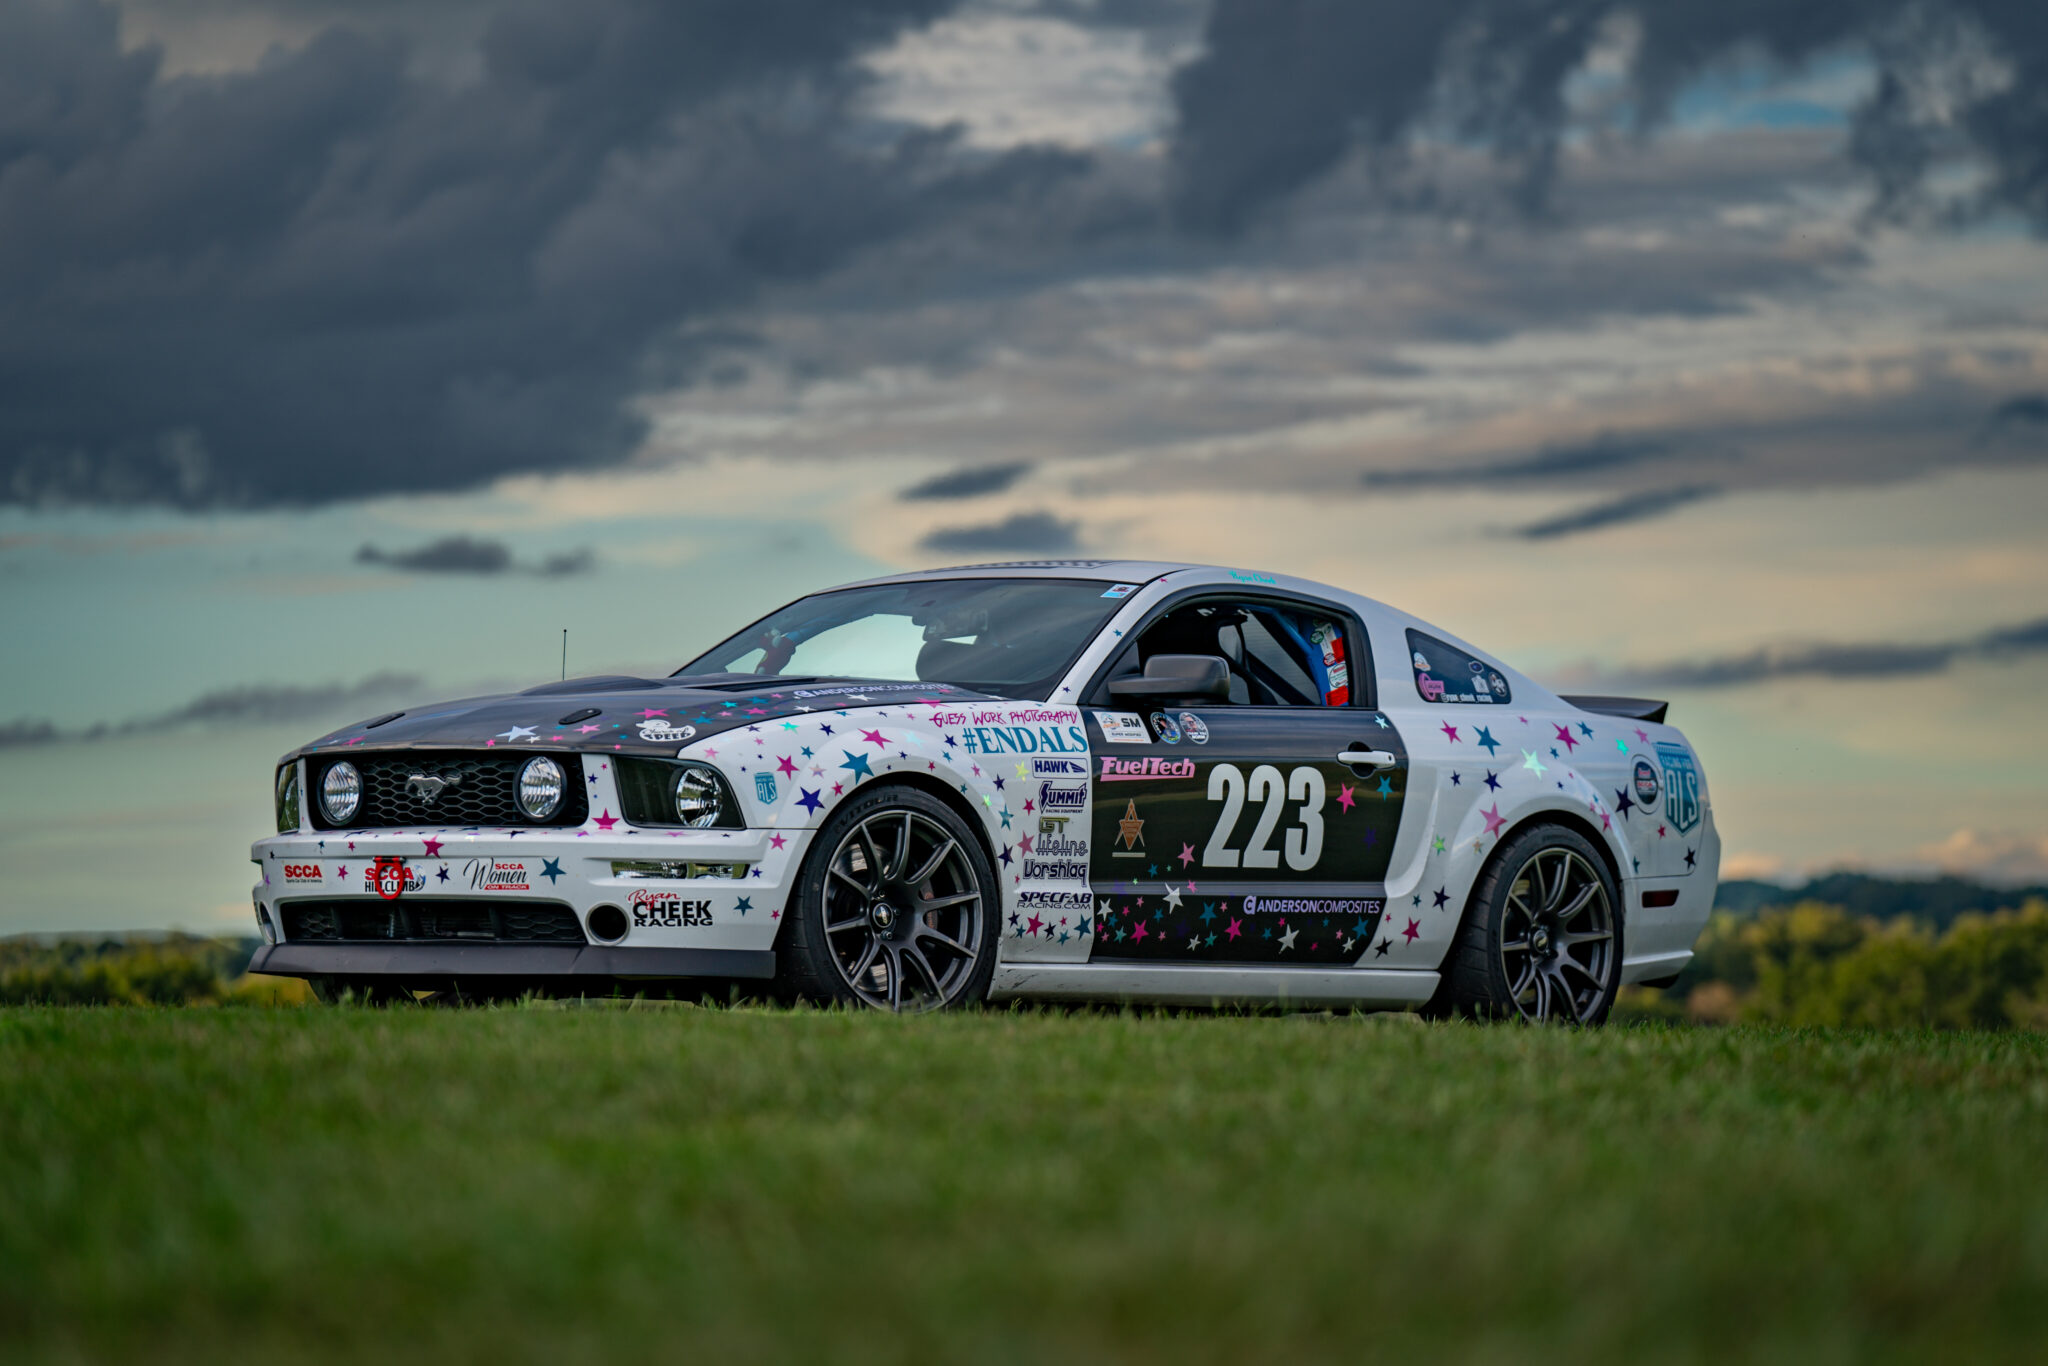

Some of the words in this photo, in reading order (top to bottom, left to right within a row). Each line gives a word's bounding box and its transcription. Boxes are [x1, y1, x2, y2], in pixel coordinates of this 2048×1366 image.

[929, 711, 967, 727] GUESS
[972, 711, 1006, 725] WORK
[1009, 709, 1078, 725] PHOTOGRAPHY
[1122, 718, 1141, 728] SM
[963, 726, 1088, 754] #ENDALS
[1034, 760, 1069, 773] HAWK
[1100, 757, 1195, 779] FuelTech
[758, 782, 775, 802] ALS
[1666, 769, 1698, 829] ALS
[1039, 816, 1070, 833] GT
[1202, 763, 1326, 871] 223
[284, 865, 322, 878] SCCA
[463, 857, 527, 890] Women
[628, 889, 680, 910] Ryan
[1017, 901, 1091, 910] RACING.COM
[1019, 892, 1092, 903] SPECFAB
[633, 900, 712, 919] CHEEK
[1257, 900, 1380, 914] ANDERSONCOMPOSITES
[634, 918, 713, 927] RACING
